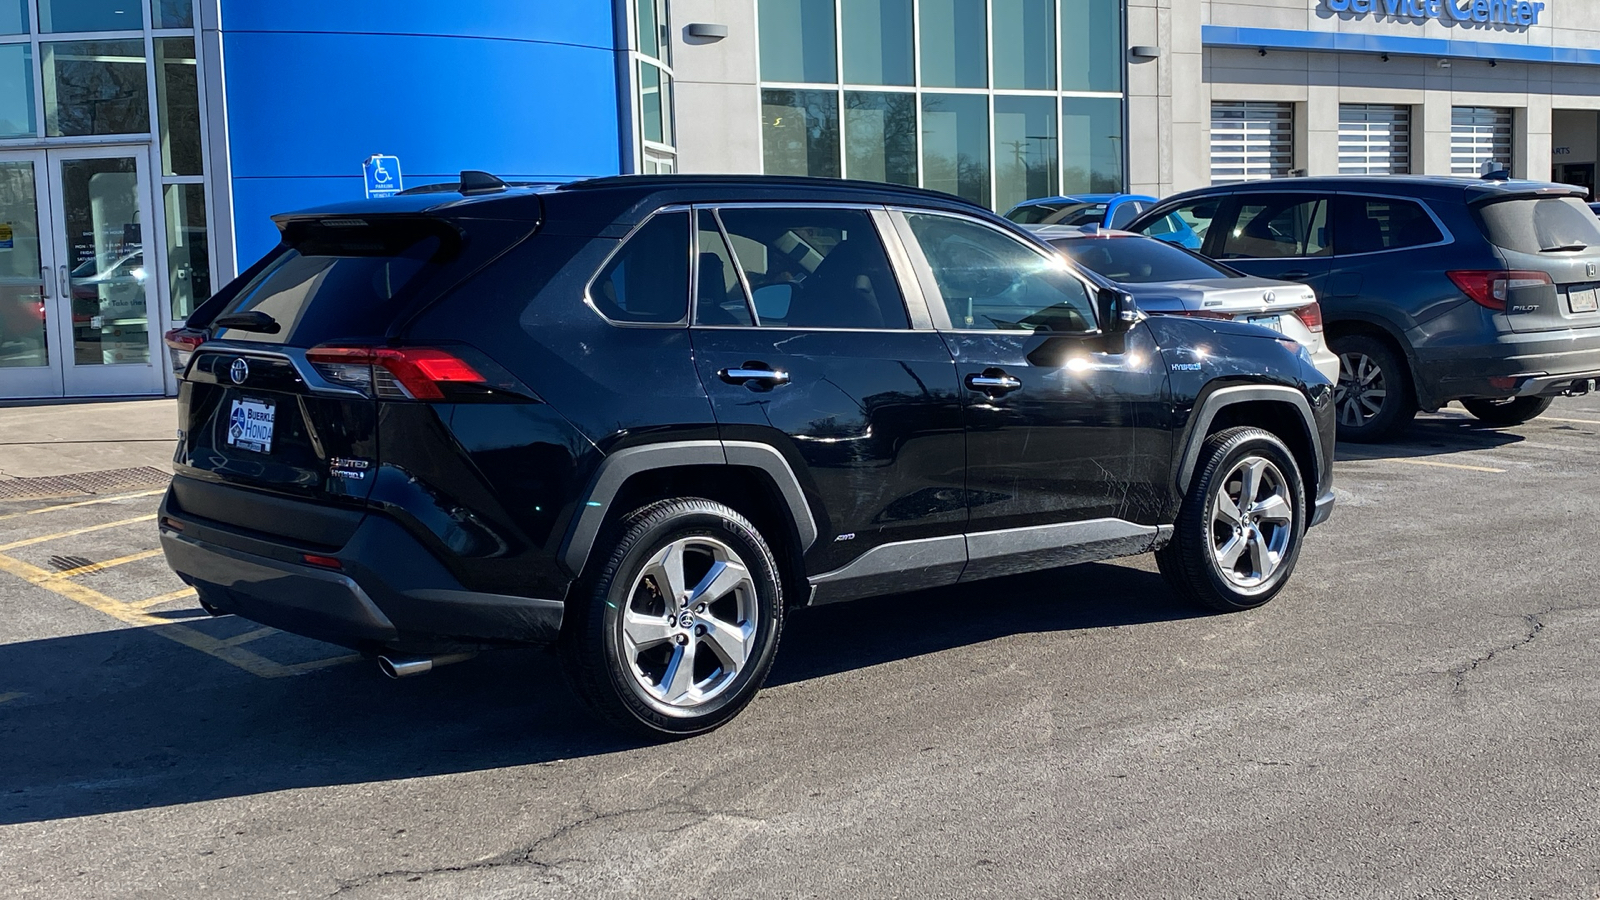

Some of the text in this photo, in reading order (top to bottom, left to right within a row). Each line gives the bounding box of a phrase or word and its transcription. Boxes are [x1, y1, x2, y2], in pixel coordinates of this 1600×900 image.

[1448, 0, 1545, 26] Center
[1552, 147, 1570, 155] ARTS
[130, 298, 142, 306] the
[247, 408, 275, 423] BUERKLE
[245, 420, 272, 441] HONDA
